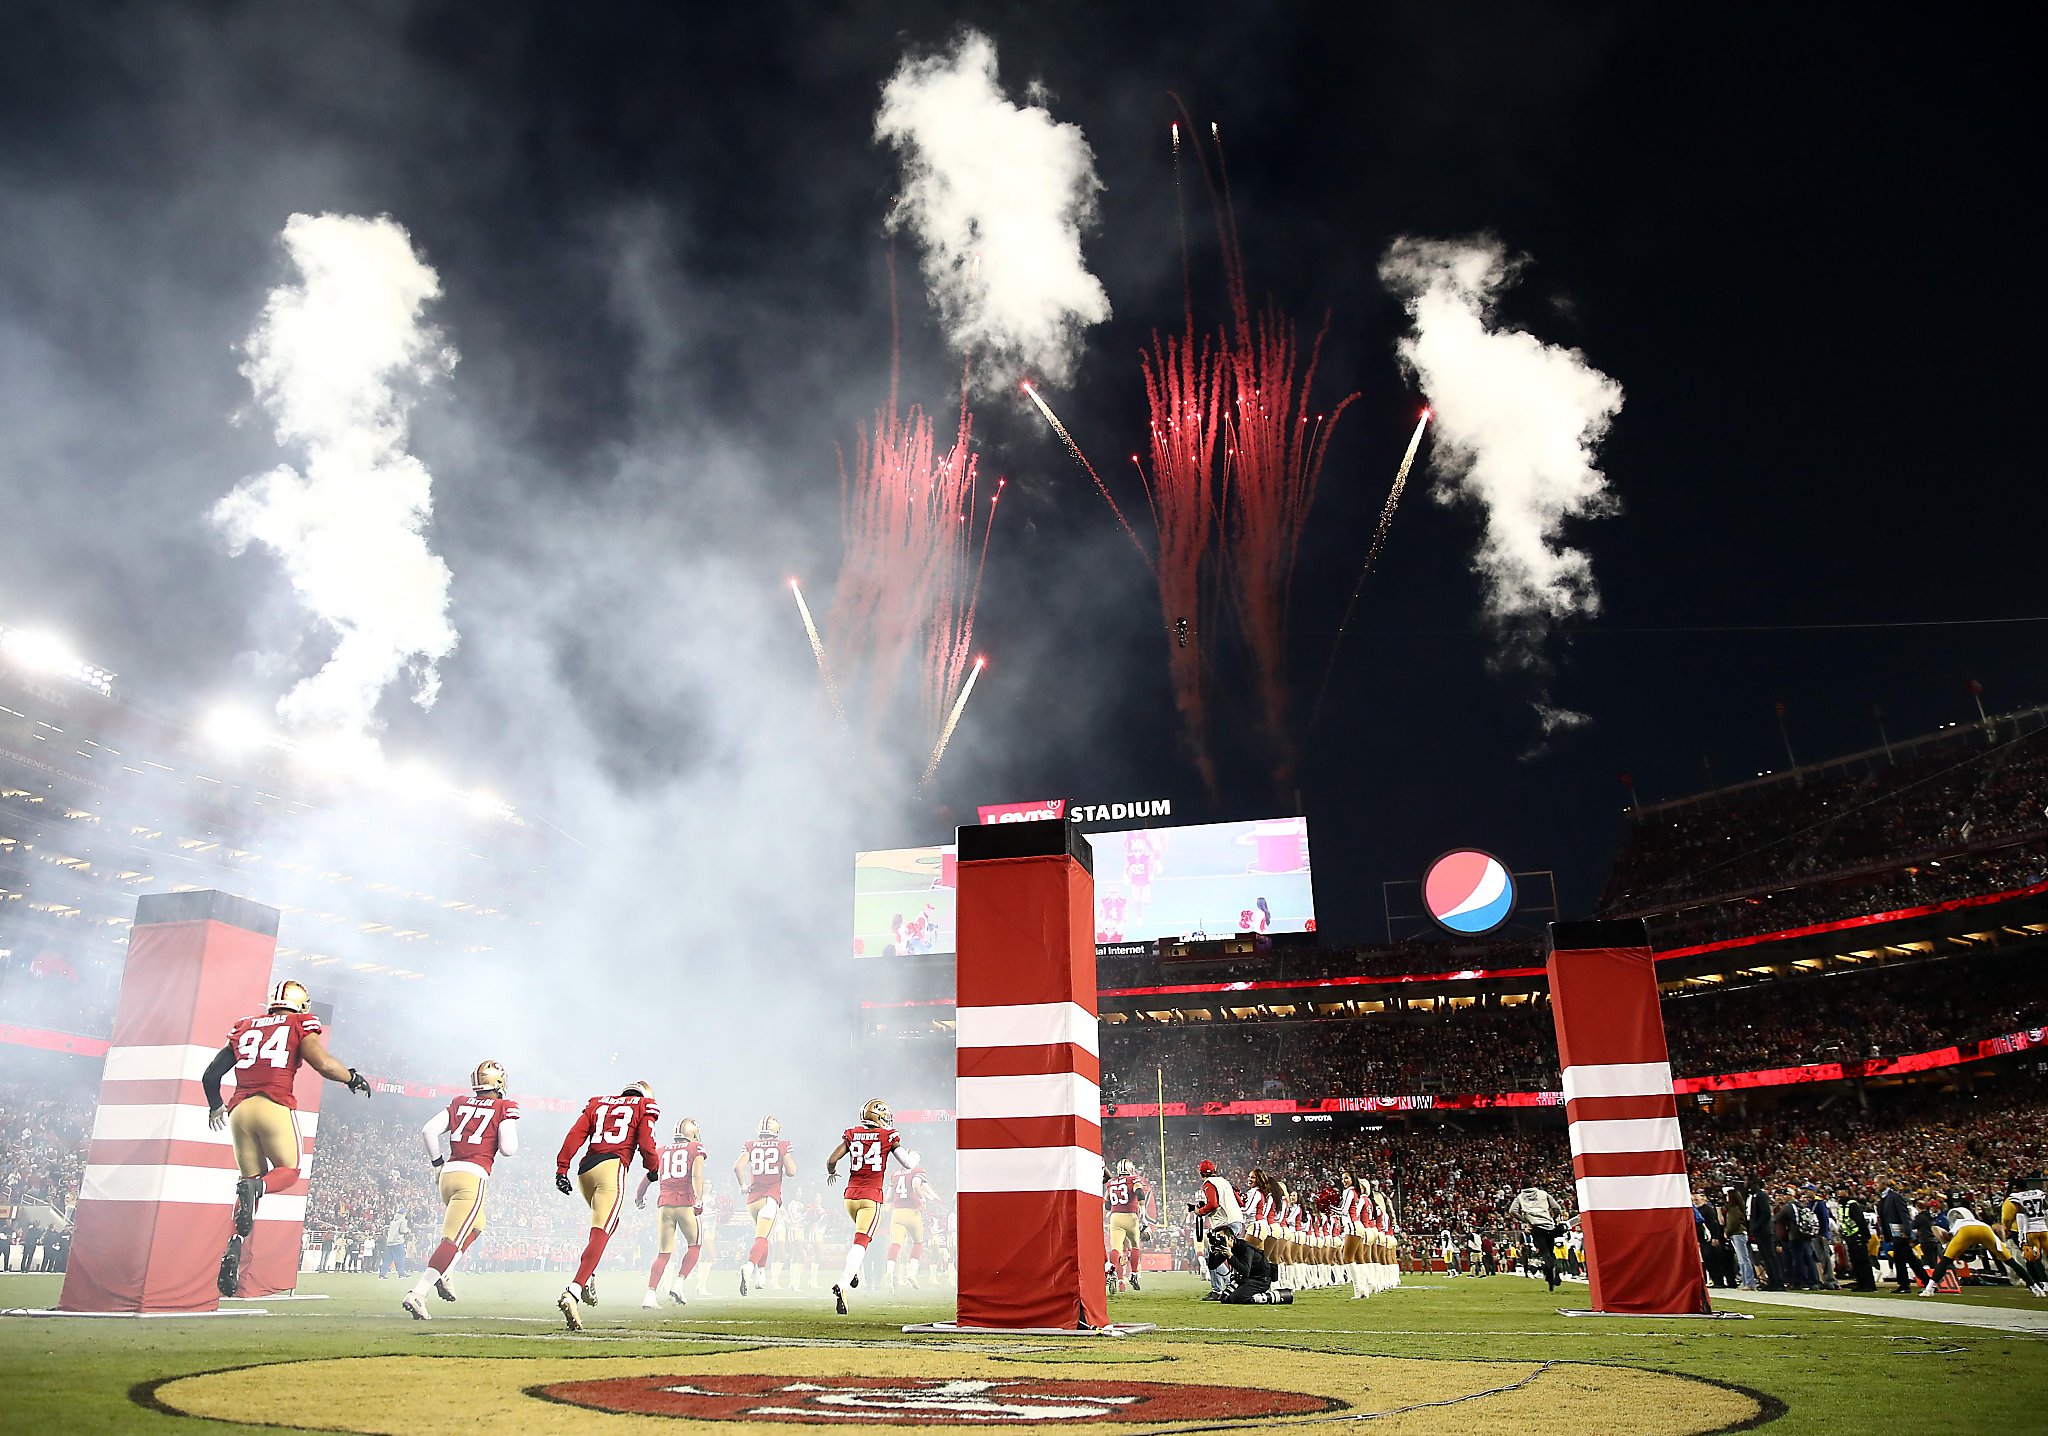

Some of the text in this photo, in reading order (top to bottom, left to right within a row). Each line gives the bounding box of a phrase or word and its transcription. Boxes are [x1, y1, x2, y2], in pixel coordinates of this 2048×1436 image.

[1070, 800, 1171, 823] STADIUM
[1108, 945, 1145, 956] Internet
[235, 1025, 291, 1069] 94
[450, 1105, 496, 1145] 77
[590, 1104, 635, 1145] 13
[660, 1149, 689, 1181] 18
[750, 1147, 780, 1175] 82
[849, 1141, 883, 1172] 84
[896, 1175, 908, 1199] 4
[1110, 1184, 1129, 1206] 63
[2023, 1199, 2045, 1218] 37
